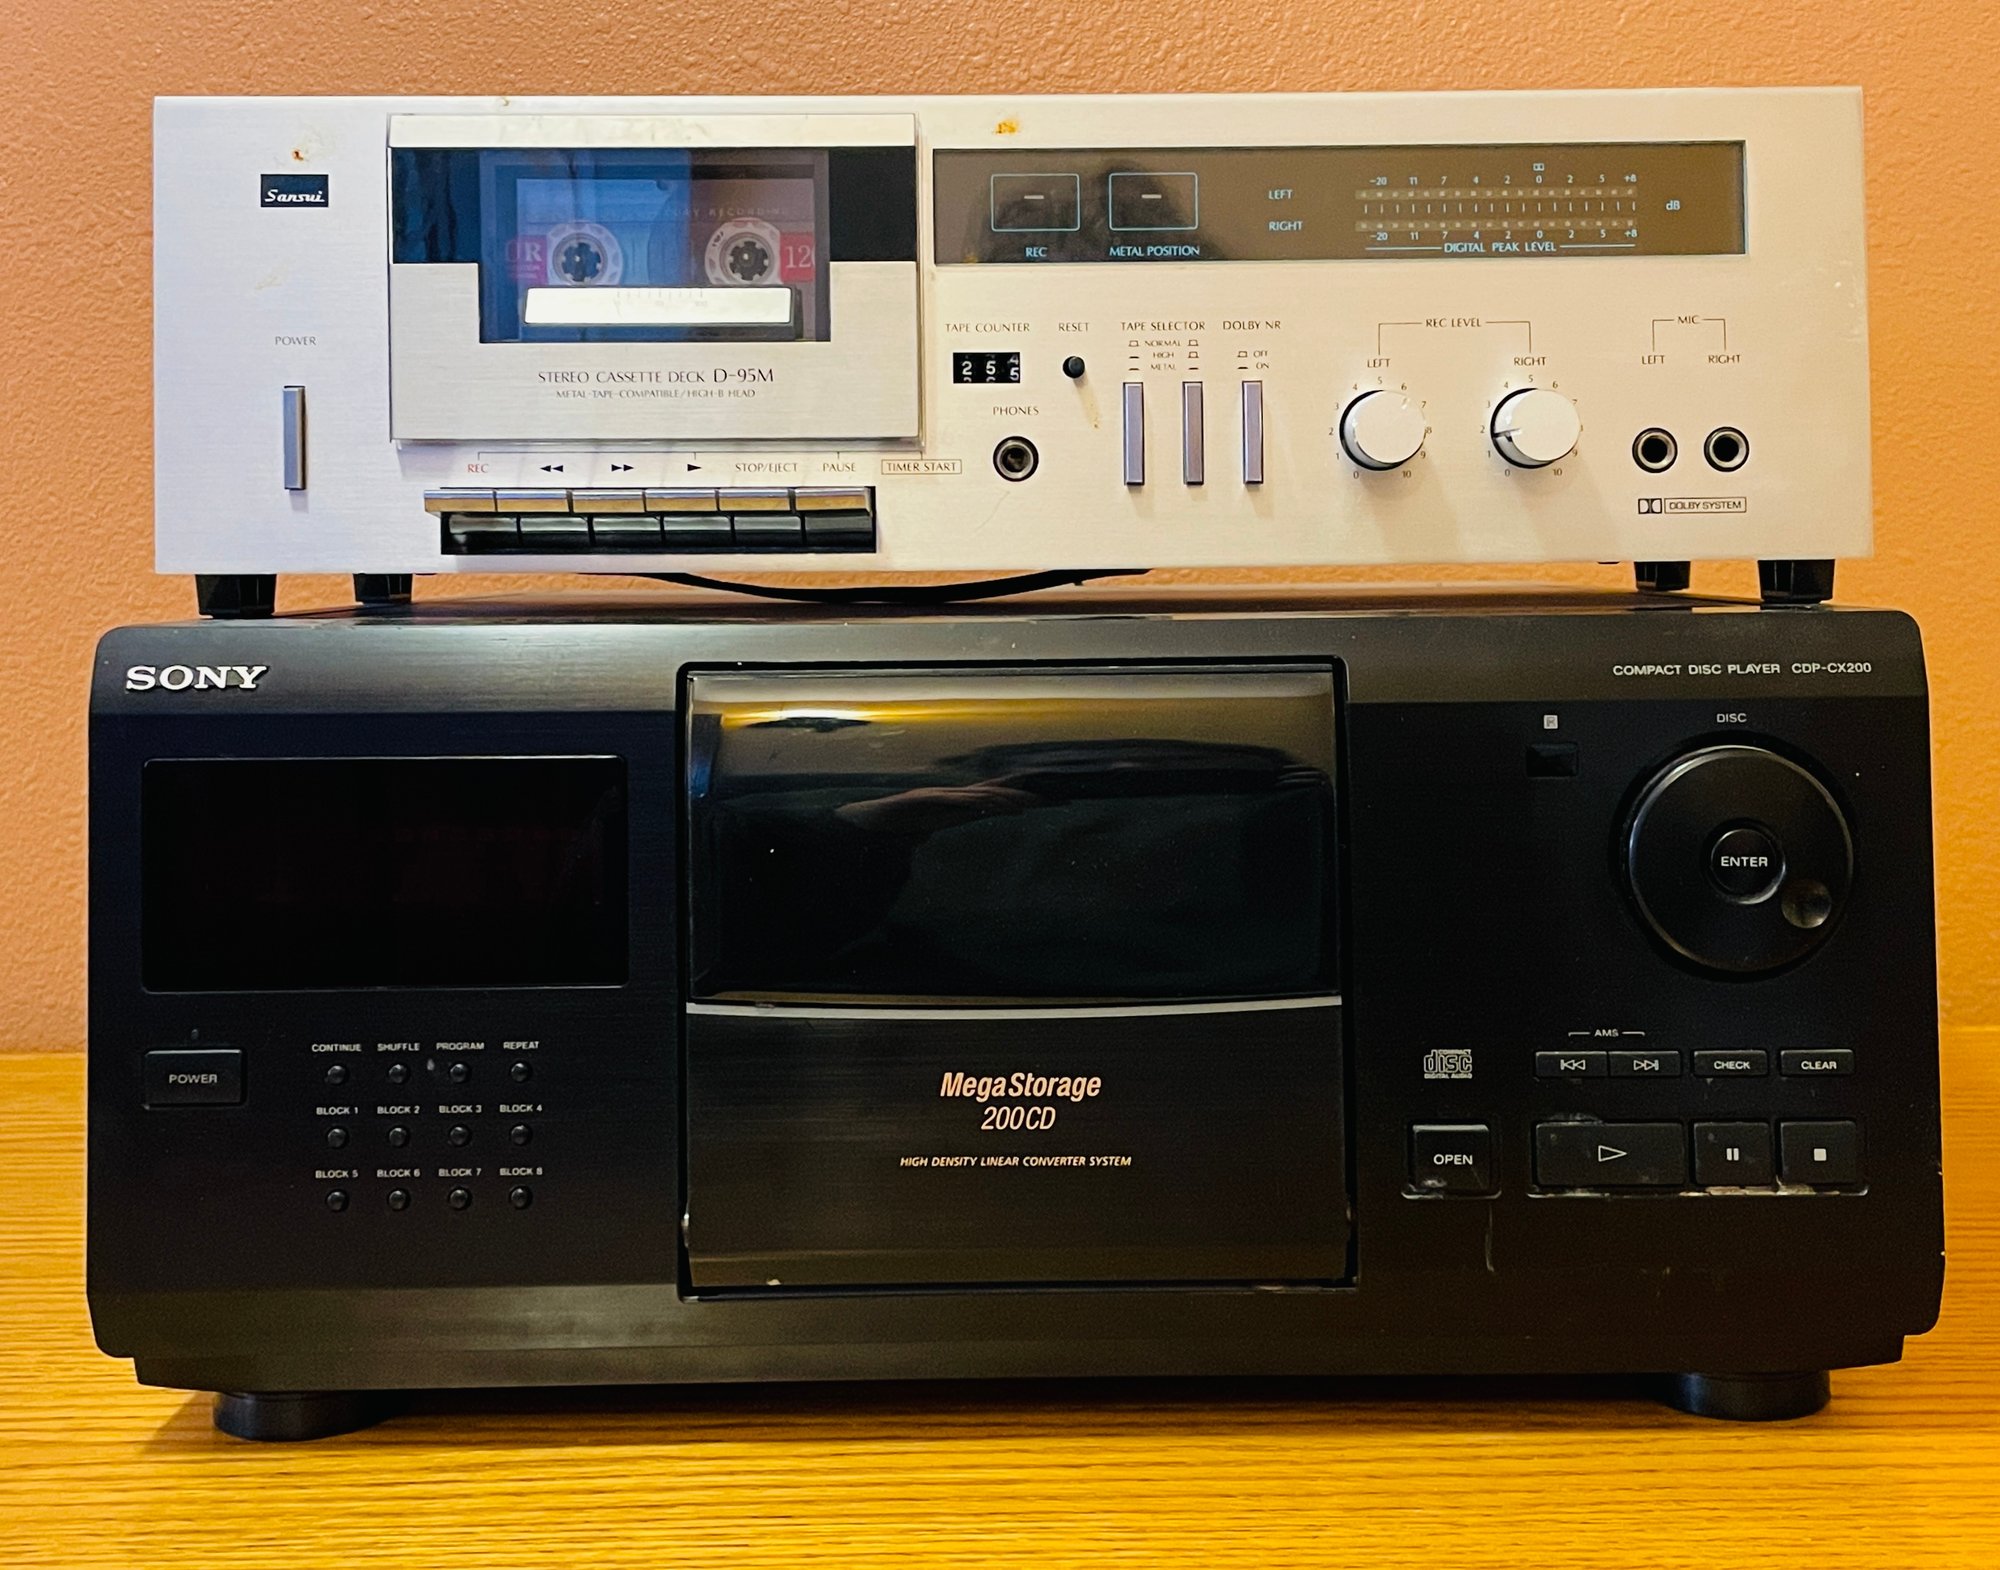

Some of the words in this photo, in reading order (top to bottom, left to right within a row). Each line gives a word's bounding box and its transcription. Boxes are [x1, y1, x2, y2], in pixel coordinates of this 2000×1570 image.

[1369, 176, 1387, 186] -20
[1409, 176, 1419, 185] 11
[1441, 176, 1448, 185] 7
[1473, 175, 1479, 184] 4
[1504, 175, 1511, 184] 2
[1536, 175, 1542, 184] 0
[1567, 174, 1573, 183] 2
[1599, 174, 1605, 183] 5
[1624, 173, 1637, 183] +8
[264, 189, 325, 202] Sansui
[1268, 189, 1293, 200] LEFT
[1665, 200, 1681, 211] dB
[1268, 221, 1303, 231] RIGHT
[1369, 231, 1388, 241] -20
[1410, 231, 1419, 240] 11
[1442, 231, 1448, 240] 7
[1473, 230, 1479, 240] 4
[1505, 230, 1511, 240] 2
[1537, 230, 1543, 239] 0
[1568, 229, 1575, 239] 2
[1600, 229, 1606, 239] 5
[1624, 229, 1638, 238] +8
[1025, 247, 1048, 257] REC
[1110, 246, 1143, 257] METAL
[1147, 246, 1200, 257] POSITION
[1444, 243, 1485, 253] DIGITAL
[1492, 242, 1520, 252] PEAK
[1525, 242, 1557, 252] LEVEL
[786, 245, 816, 269] 12
[1426, 318, 1447, 328] REC
[1451, 317, 1482, 327] LEVEL
[1678, 315, 1700, 324] MIC
[945, 323, 970, 332] TAPE
[975, 323, 1030, 332] COUNTER
[1058, 322, 1090, 332] RESET
[1121, 322, 1145, 331] TAPE
[1150, 321, 1206, 331] SELECTOR
[1222, 320, 1261, 330] DOLBY
[1265, 320, 1281, 330] NR
[274, 336, 317, 346] POWER
[1253, 350, 1268, 358] OFF
[1708, 354, 1741, 364] RIGHT
[1367, 358, 1391, 369] LEFT
[1513, 357, 1546, 367] RIGHT
[1641, 355, 1665, 365] LEFT
[1255, 362, 1270, 370] ON
[538, 370, 589, 383] STEREO
[596, 370, 662, 383] CASSETTE
[668, 370, 705, 383] DECK
[713, 368, 774, 383] D-95M
[1378, 376, 1383, 385] 5
[1529, 374, 1534, 383] 5
[1352, 383, 1358, 391] 4
[1401, 383, 1408, 391] 6
[1504, 381, 1509, 389] 4
[1552, 381, 1559, 389] 6
[728, 389, 756, 398] HEAD
[1420, 400, 1427, 409] 7
[993, 406, 1040, 416] PHONES
[1328, 427, 1334, 436] 2
[1480, 425, 1485, 434] 2
[1420, 451, 1426, 459] 9
[1572, 449, 1578, 457] 9
[467, 463, 489, 473] REC
[735, 462, 798, 473] STOP/EJECT
[822, 462, 857, 472] PAUSE
[886, 461, 919, 472] TIMER
[923, 461, 956, 472] START
[1353, 471, 1360, 480] 0
[1402, 470, 1412, 479] 10
[1504, 469, 1511, 478] 0
[1553, 468, 1563, 477] 10
[1669, 501, 1700, 510] DOLBY
[1703, 500, 1742, 510] SYSTEM
[1613, 664, 1682, 676] COMPACT
[1688, 664, 1722, 675] DISC
[1728, 663, 1781, 675] PLAYER
[1791, 662, 1872, 674] CDP-CX200
[125, 665, 268, 691] SONY
[1716, 713, 1747, 723] DISC
[1721, 856, 1769, 868] ENTER
[1594, 1029, 1620, 1038] AMS
[311, 1043, 362, 1052] CONTINUE
[377, 1042, 420, 1052] SHUFFLE
[436, 1041, 485, 1051] PROGRAM
[503, 1041, 540, 1050] REPEAT
[1423, 1049, 1473, 1073] disc
[1714, 1059, 1751, 1070] CHECK
[1801, 1059, 1837, 1070] CLEAR
[169, 1073, 218, 1084] POWER
[940, 1072, 1102, 1102] MegaStorage
[316, 1106, 350, 1115] BLOCK
[353, 1106, 358, 1114] 1
[377, 1105, 410, 1114] BLOCK
[413, 1105, 420, 1114] 2
[439, 1104, 472, 1113] BLOCK
[475, 1104, 482, 1113] 3
[500, 1103, 533, 1112] BLOCK
[536, 1103, 543, 1112] 4
[900, 1156, 928, 1167] HIGH
[931, 1156, 977, 1167] DENSITY
[980, 1156, 1019, 1166] LINEAR
[1022, 1156, 1085, 1166] CONVERTER
[1089, 1156, 1132, 1166] SYSTEM
[1433, 1154, 1473, 1165] OPEN
[315, 1169, 349, 1178] BLOCK
[352, 1169, 358, 1178] 5
[377, 1168, 410, 1178] BLOCK
[413, 1168, 420, 1177] 6
[438, 1168, 471, 1177] BLOCK
[475, 1168, 482, 1176] 7
[500, 1167, 533, 1176] BLOCK
[536, 1167, 543, 1176] 8
